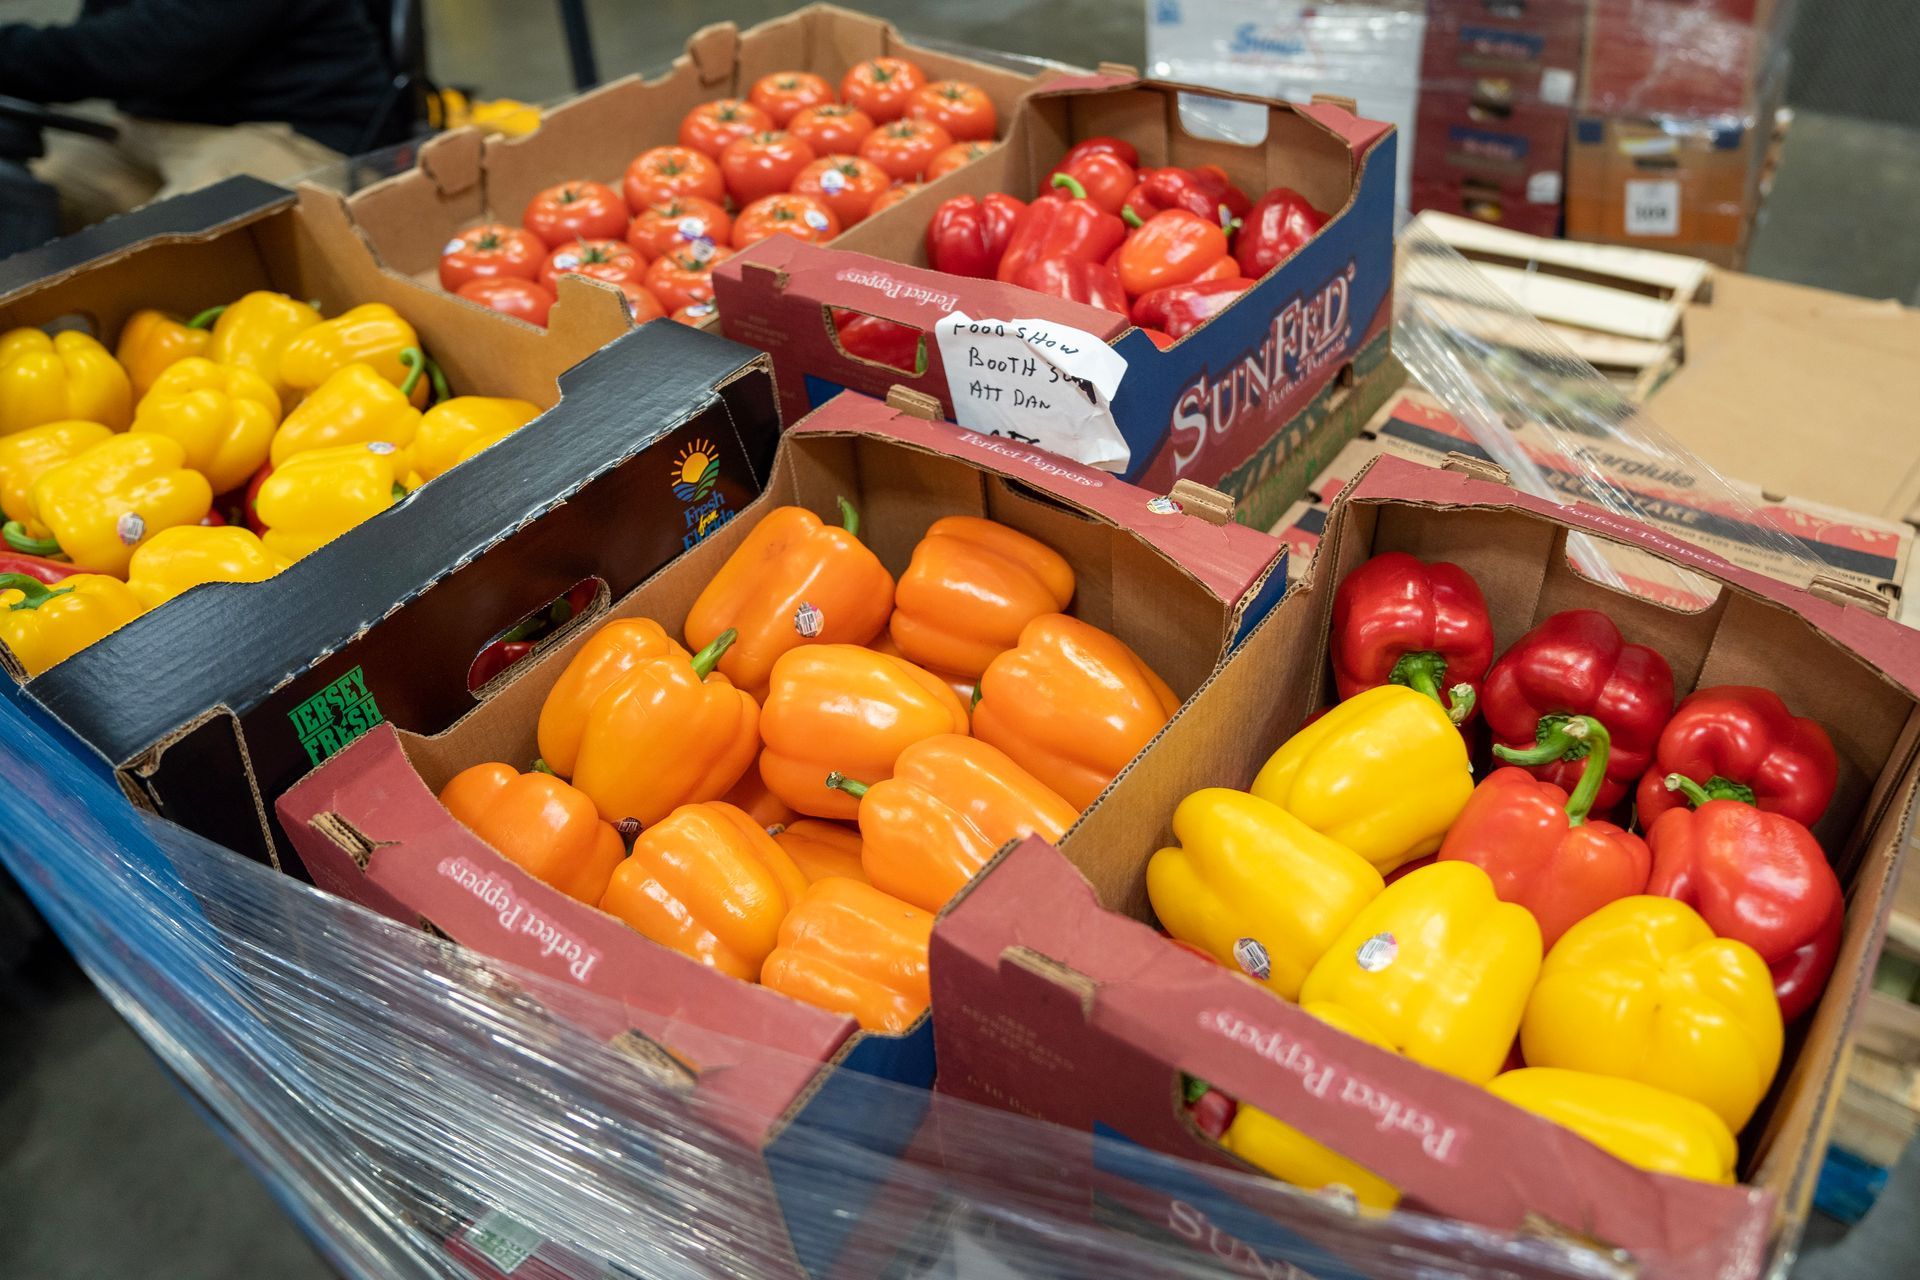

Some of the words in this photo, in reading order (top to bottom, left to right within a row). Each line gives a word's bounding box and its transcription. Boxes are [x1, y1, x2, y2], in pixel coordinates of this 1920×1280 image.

[846, 271, 903, 299] Peppers
[903, 286, 959, 313] Perfect
[953, 323, 1005, 337] FOOD
[1016, 327, 1079, 354] SHOW
[969, 347, 1037, 377] BOOTH
[1014, 388, 1051, 409] DAN
[1171, 274, 1349, 476] SUNFED
[960, 433, 1022, 459] Perfect
[1023, 453, 1093, 487] Peppers
[684, 490, 726, 529] Fresh
[1557, 503, 1633, 534] Perfect
[1639, 529, 1725, 569] Peppers
[289, 667, 368, 741] JERSEY
[303, 696, 384, 767] FRESH
[449, 861, 523, 931] Peppers
[519, 913, 597, 983] Perfect
[1215, 1011, 1335, 1099] Peppers
[1339, 1075, 1456, 1162] Perfect
